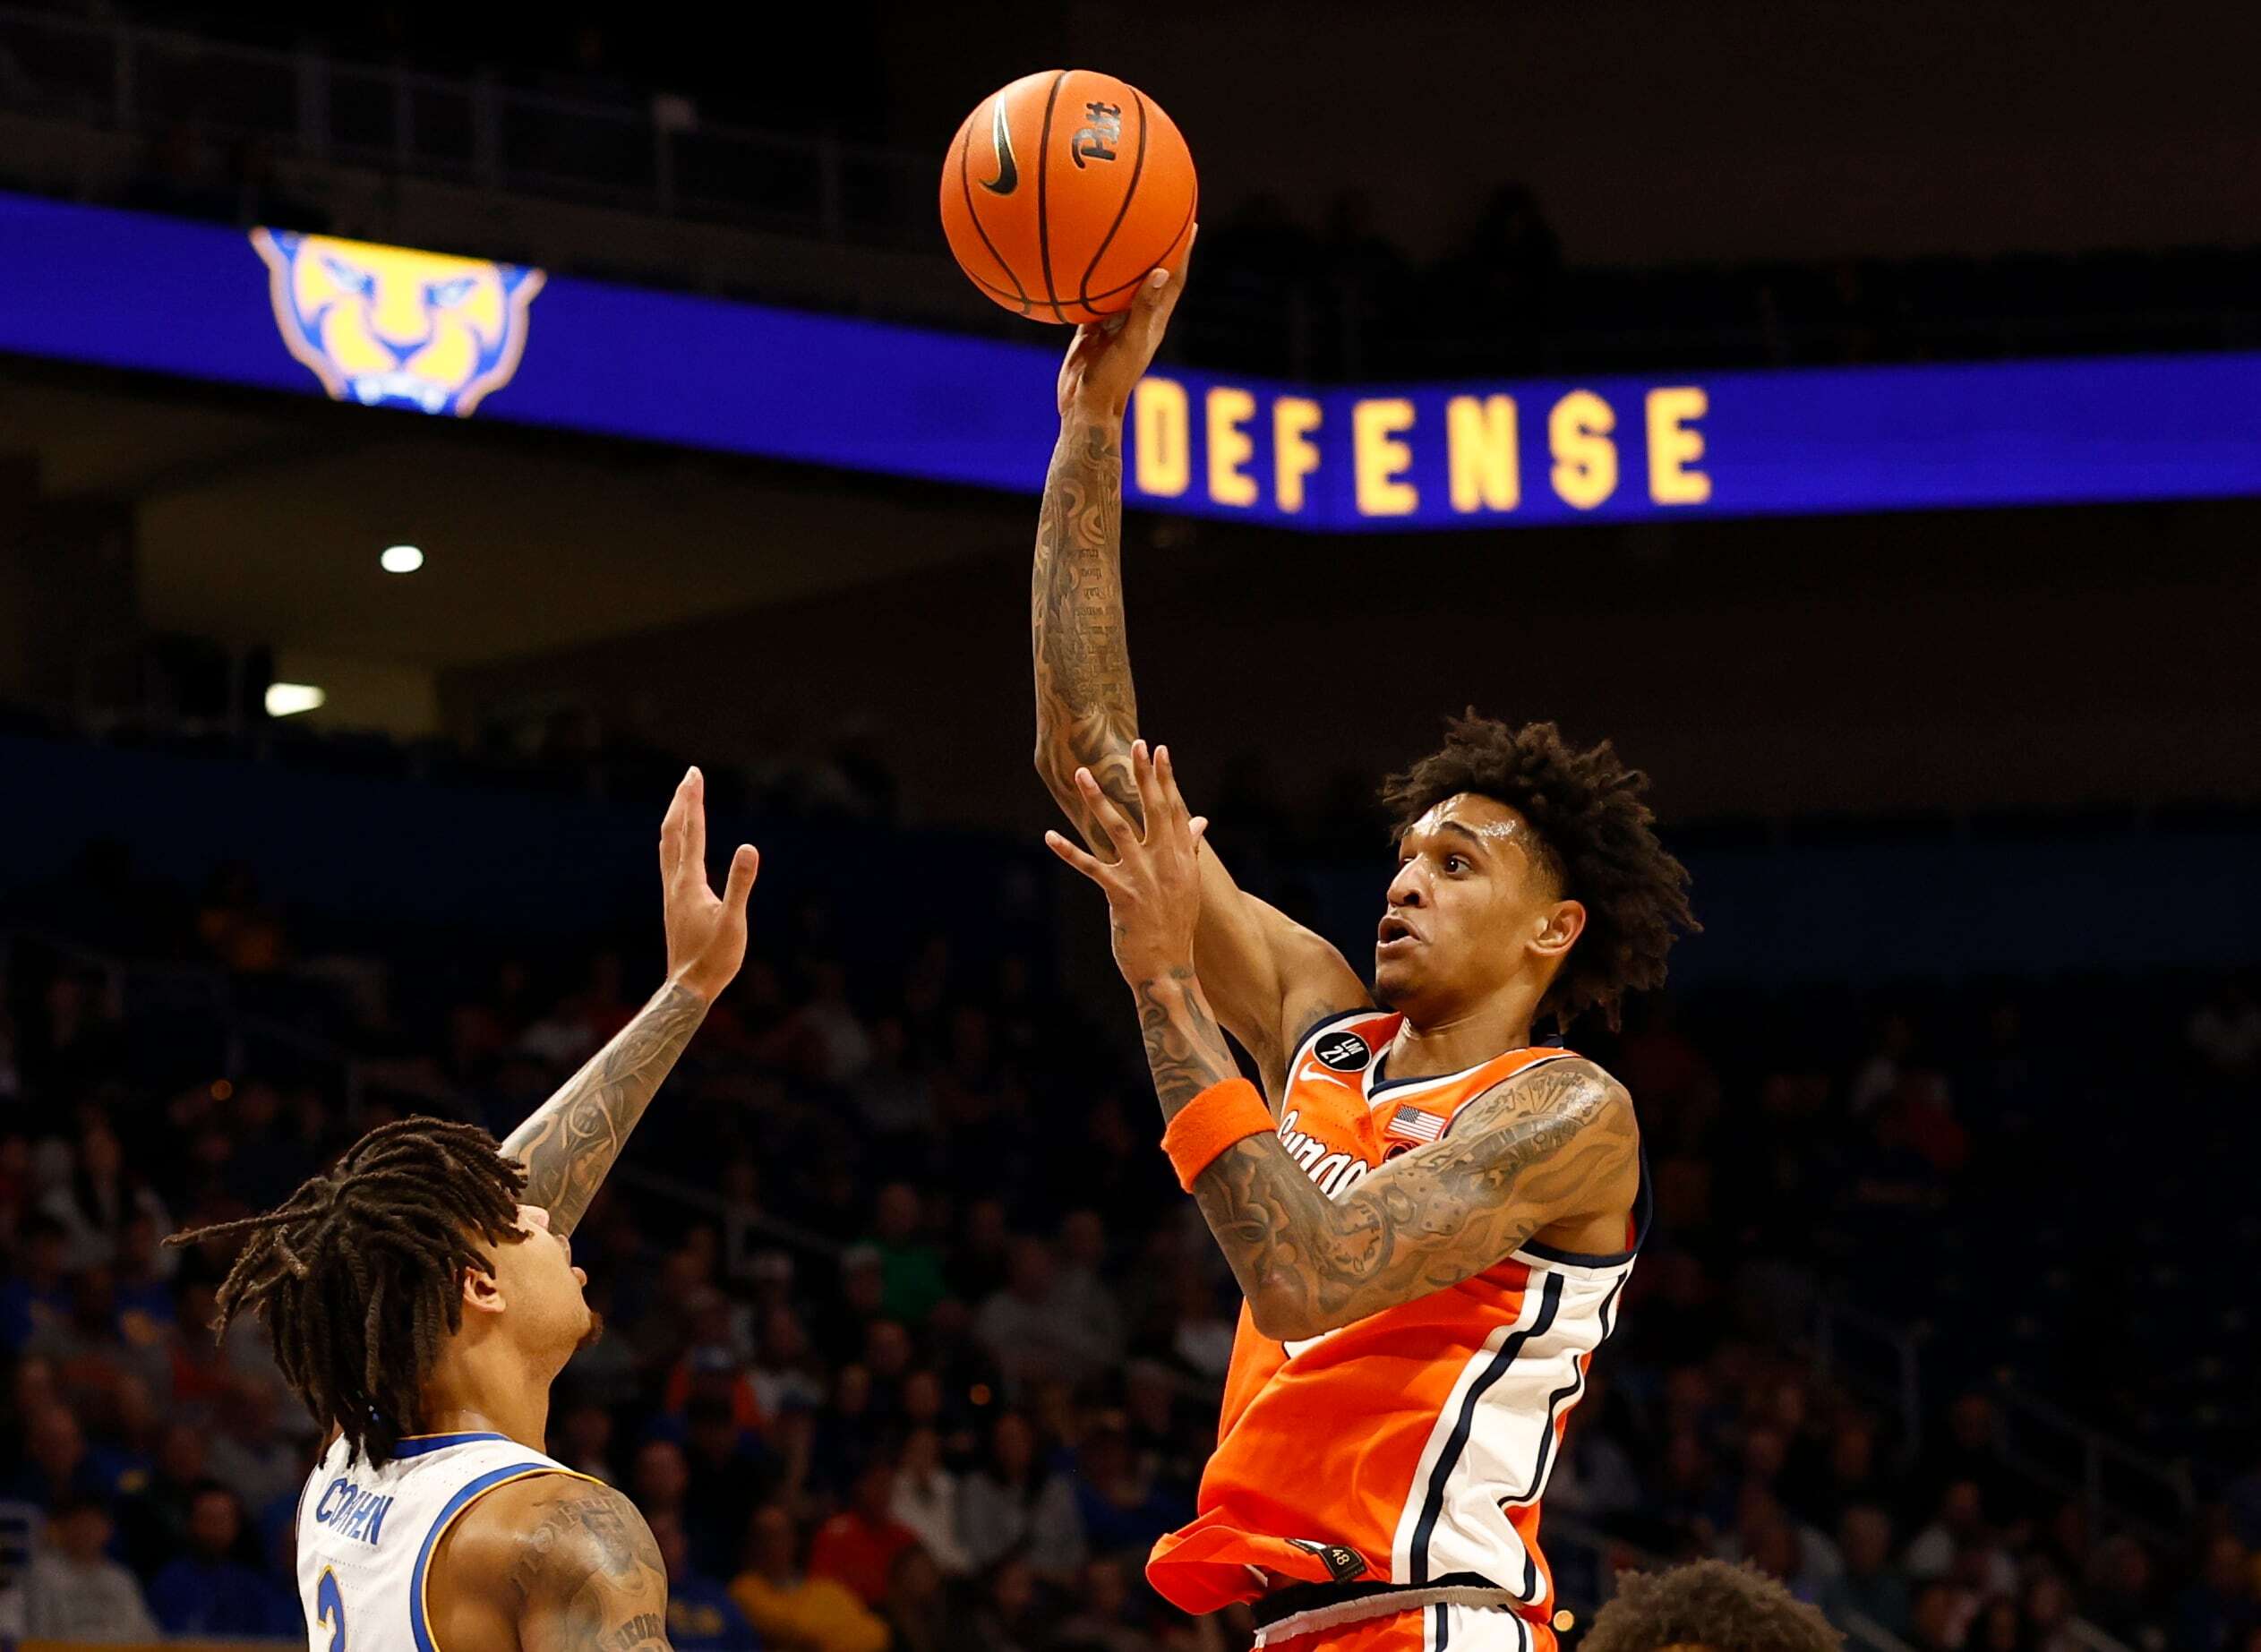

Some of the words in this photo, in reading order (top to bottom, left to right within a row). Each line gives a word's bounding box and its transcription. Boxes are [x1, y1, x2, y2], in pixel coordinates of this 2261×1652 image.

[1072, 101, 1121, 169] Pitt
[1134, 376, 1710, 516] DEFENSE
[1320, 1045, 1350, 1064] 21
[1341, 1038, 1364, 1055] LM
[1332, 1549, 1350, 1566] 48
